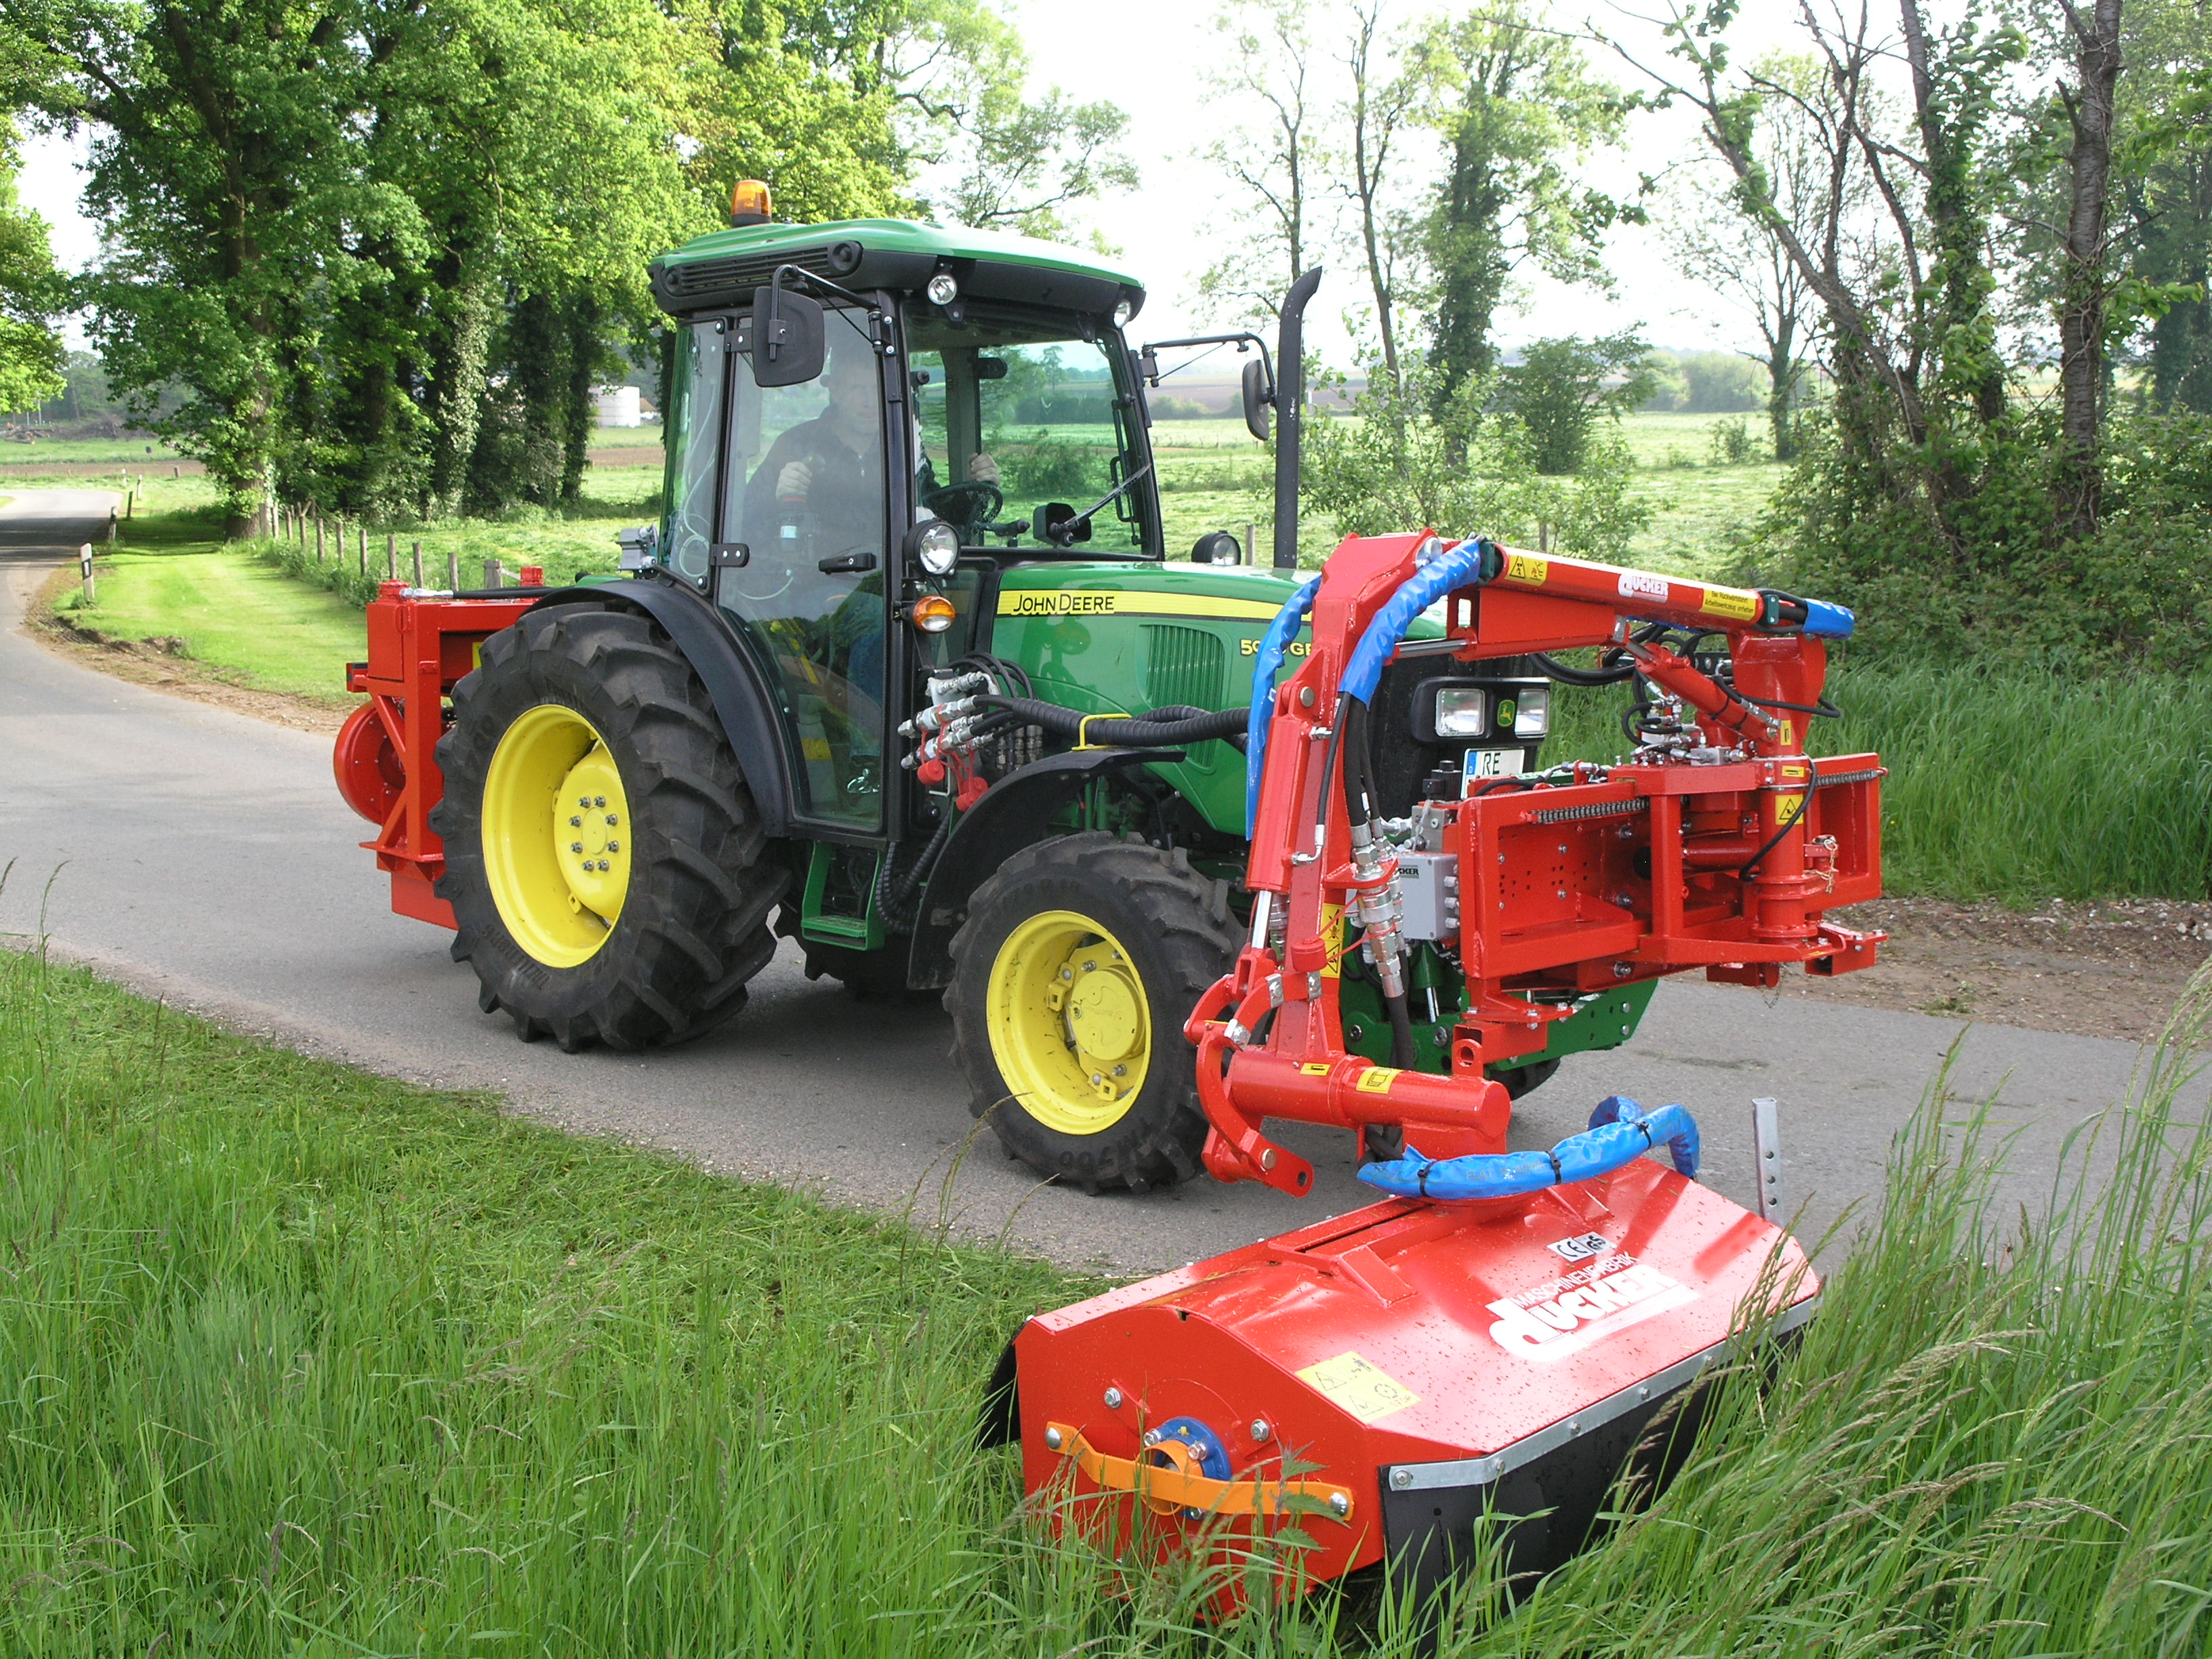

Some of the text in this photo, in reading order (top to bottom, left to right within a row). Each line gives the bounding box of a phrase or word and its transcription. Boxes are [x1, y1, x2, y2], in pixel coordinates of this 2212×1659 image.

[1014, 594, 1115, 612] JOHN DEERE
[1482, 752, 1501, 775] RE
[1509, 1251, 1640, 1309] MASCHINENFABRIK
